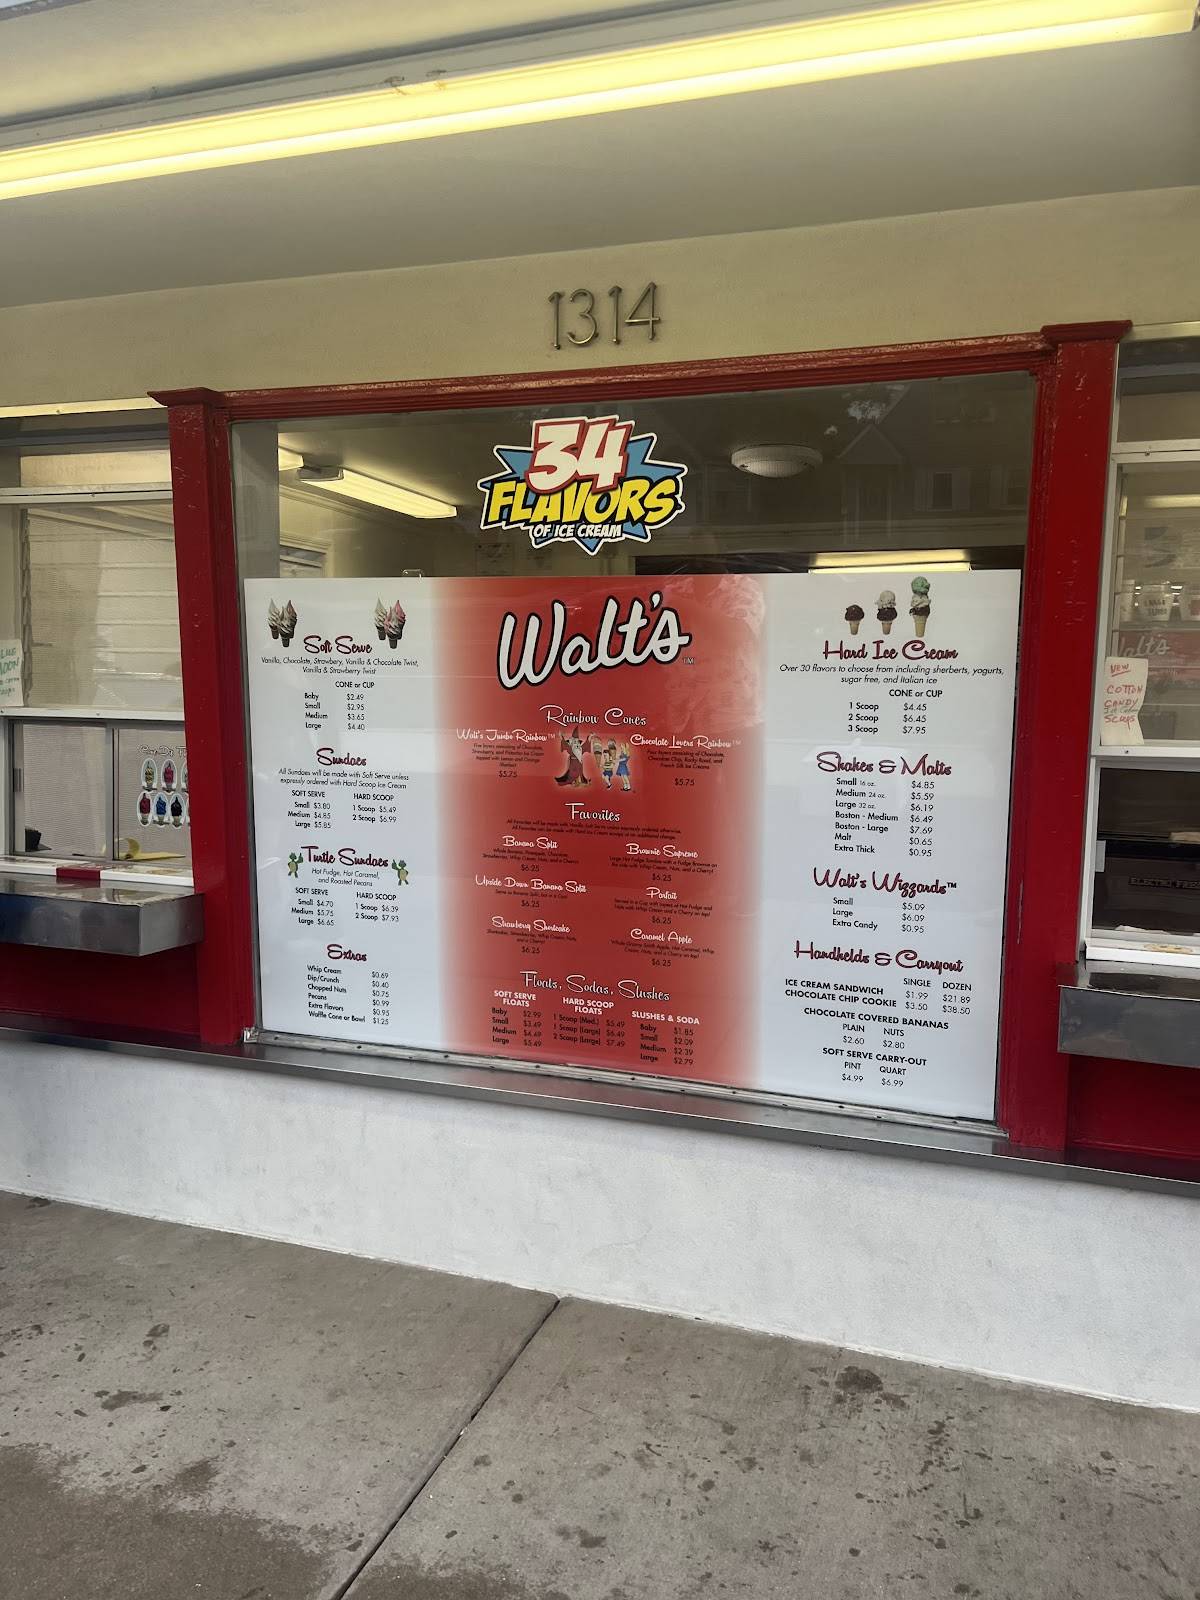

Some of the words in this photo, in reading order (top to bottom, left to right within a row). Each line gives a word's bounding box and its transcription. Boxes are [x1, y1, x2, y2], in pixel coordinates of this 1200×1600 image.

[548, 281, 661, 350] 1314
[525, 418, 634, 494] 34
[486, 476, 679, 525] FLAVORS
[533, 524, 552, 538] OF
[554, 524, 576, 538] ICE
[577, 524, 623, 538] CREAM
[303, 635, 333, 654] Soft
[334, 635, 373, 655] Serve
[497, 590, 692, 690] Walt's
[823, 640, 868, 660] Hard
[872, 639, 899, 660] Ice
[901, 639, 959, 661] Cream
[1110, 663, 1129, 674] NEW
[335, 680, 353, 688] CONE
[362, 681, 375, 689] CUP
[1106, 684, 1143, 695] COTTON
[304, 692, 319, 701] Baby
[346, 693, 364, 701] $2.49
[889, 689, 913, 697] CONE
[925, 690, 943, 698] CUP
[304, 702, 321, 710] Small
[346, 703, 365, 711] $2.95
[849, 702, 853, 710] 1
[855, 702, 879, 712] Scoop
[903, 703, 927, 712] $4.45
[1104, 698, 1139, 711] CANDY
[305, 712, 328, 720] Medium
[347, 713, 365, 721] $3.65
[540, 704, 599, 727] Rainbow
[604, 707, 647, 726] Cones
[848, 713, 854, 721] 2
[855, 713, 879, 723] Scoop
[902, 714, 927, 723] $6.45
[305, 722, 322, 731] Large
[347, 723, 365, 731] $4.40
[847, 725, 853, 733] 3
[855, 725, 878, 735] Scoop
[902, 726, 926, 735] $7.95
[316, 747, 367, 767] Sundaes
[816, 751, 874, 774] Shakes
[878, 759, 897, 774] &
[900, 753, 952, 776] Malts
[836, 777, 857, 786] Small
[911, 780, 935, 789] $4.85
[835, 788, 867, 798] Medium
[910, 792, 934, 801] $5.59
[565, 803, 621, 821] Favorites
[835, 800, 857, 810] Large
[910, 803, 934, 812] $6.19
[835, 811, 860, 820] Boston
[867, 812, 899, 822] Medium
[909, 815, 934, 824] $6.49
[835, 822, 860, 831] Boston
[867, 824, 889, 833] Large
[909, 826, 933, 835] $7.69
[502, 835, 534, 848] Banana
[536, 836, 558, 850] Split
[834, 833, 852, 841] Malt
[909, 837, 933, 846] $0.65
[300, 845, 336, 864] Turtle
[338, 848, 389, 867] Sundaes
[625, 843, 660, 856] Brownie
[662, 845, 698, 859] Supreme
[834, 844, 854, 852] Extra
[855, 845, 875, 854] Thick
[908, 848, 932, 858] $0.95
[813, 867, 867, 889] Walt's
[646, 886, 677, 900] Parfait
[832, 897, 854, 906] Small
[902, 902, 925, 911] $5.09
[832, 908, 854, 917] Large
[901, 913, 925, 922] $6.09
[832, 919, 852, 927] Extra
[853, 920, 878, 931] Candy
[901, 924, 925, 934] $0.95
[630, 928, 665, 942] Caramel
[667, 931, 693, 944] Apple
[326, 943, 368, 962] Extras
[793, 940, 870, 964] Handhelds
[874, 952, 893, 967] &
[895, 949, 964, 975] Carryout
[307, 965, 323, 974] Whip
[323, 967, 342, 975] Cream
[371, 971, 389, 979] $0.69
[307, 975, 340, 984] Dip/Crunch
[372, 980, 389, 989] $0.40
[520, 970, 562, 990] Floats,
[566, 974, 613, 995] Sodas,
[618, 980, 670, 1001] Slushes
[903, 977, 931, 988] SINGLE
[942, 981, 972, 991] DOZEN
[307, 983, 333, 992] Chopped
[333, 986, 347, 994] Nuts
[372, 990, 390, 998] $0.75
[493, 990, 512, 998] SOFT
[513, 992, 537, 1001] SERVE
[785, 978, 798, 986] ICE
[800, 980, 831, 990] CREAM
[833, 983, 884, 995] SANDWICH
[905, 990, 929, 1000] $1.99
[942, 994, 971, 1004] $21.89
[308, 993, 327, 1001] Pecans
[372, 999, 390, 1007] $0.99
[502, 998, 530, 1008] FLOATS
[562, 997, 585, 1006] HARD
[586, 1000, 615, 1009] SCOOP
[785, 989, 836, 1001] CHOCOLATE
[838, 994, 860, 1003] CHIP
[862, 997, 897, 1008] COOKIE
[905, 1001, 928, 1011] $3.50
[942, 1005, 971, 1015] $38.50
[308, 1002, 323, 1010] Extra
[324, 1003, 344, 1012] Flavors
[373, 1008, 390, 1017] $0.95
[574, 1006, 603, 1015] FLOATS
[308, 1010, 327, 1019] Waffle
[328, 1012, 343, 1020] Cone
[351, 1015, 366, 1023] Bowl
[373, 1017, 389, 1026] $1.25
[631, 1010, 666, 1021] SLUSHES
[667, 1014, 674, 1022] &
[676, 1015, 700, 1025] SODA
[803, 1007, 856, 1020] CHOCOLATE
[857, 1013, 899, 1024] COVERED
[902, 1017, 949, 1030] BANANAS
[842, 1023, 865, 1033] PLAIN
[883, 1027, 905, 1037] NUTS
[842, 1035, 865, 1045] $2.60
[882, 1039, 905, 1049] $2.80
[822, 1047, 844, 1057] SOFT
[846, 1050, 873, 1060] SERVE
[875, 1053, 927, 1067] CARRY-OUT
[844, 1061, 861, 1070] PINT
[879, 1066, 907, 1076] QUART
[841, 1073, 864, 1083] $4.99
[881, 1078, 904, 1088] $6.99
